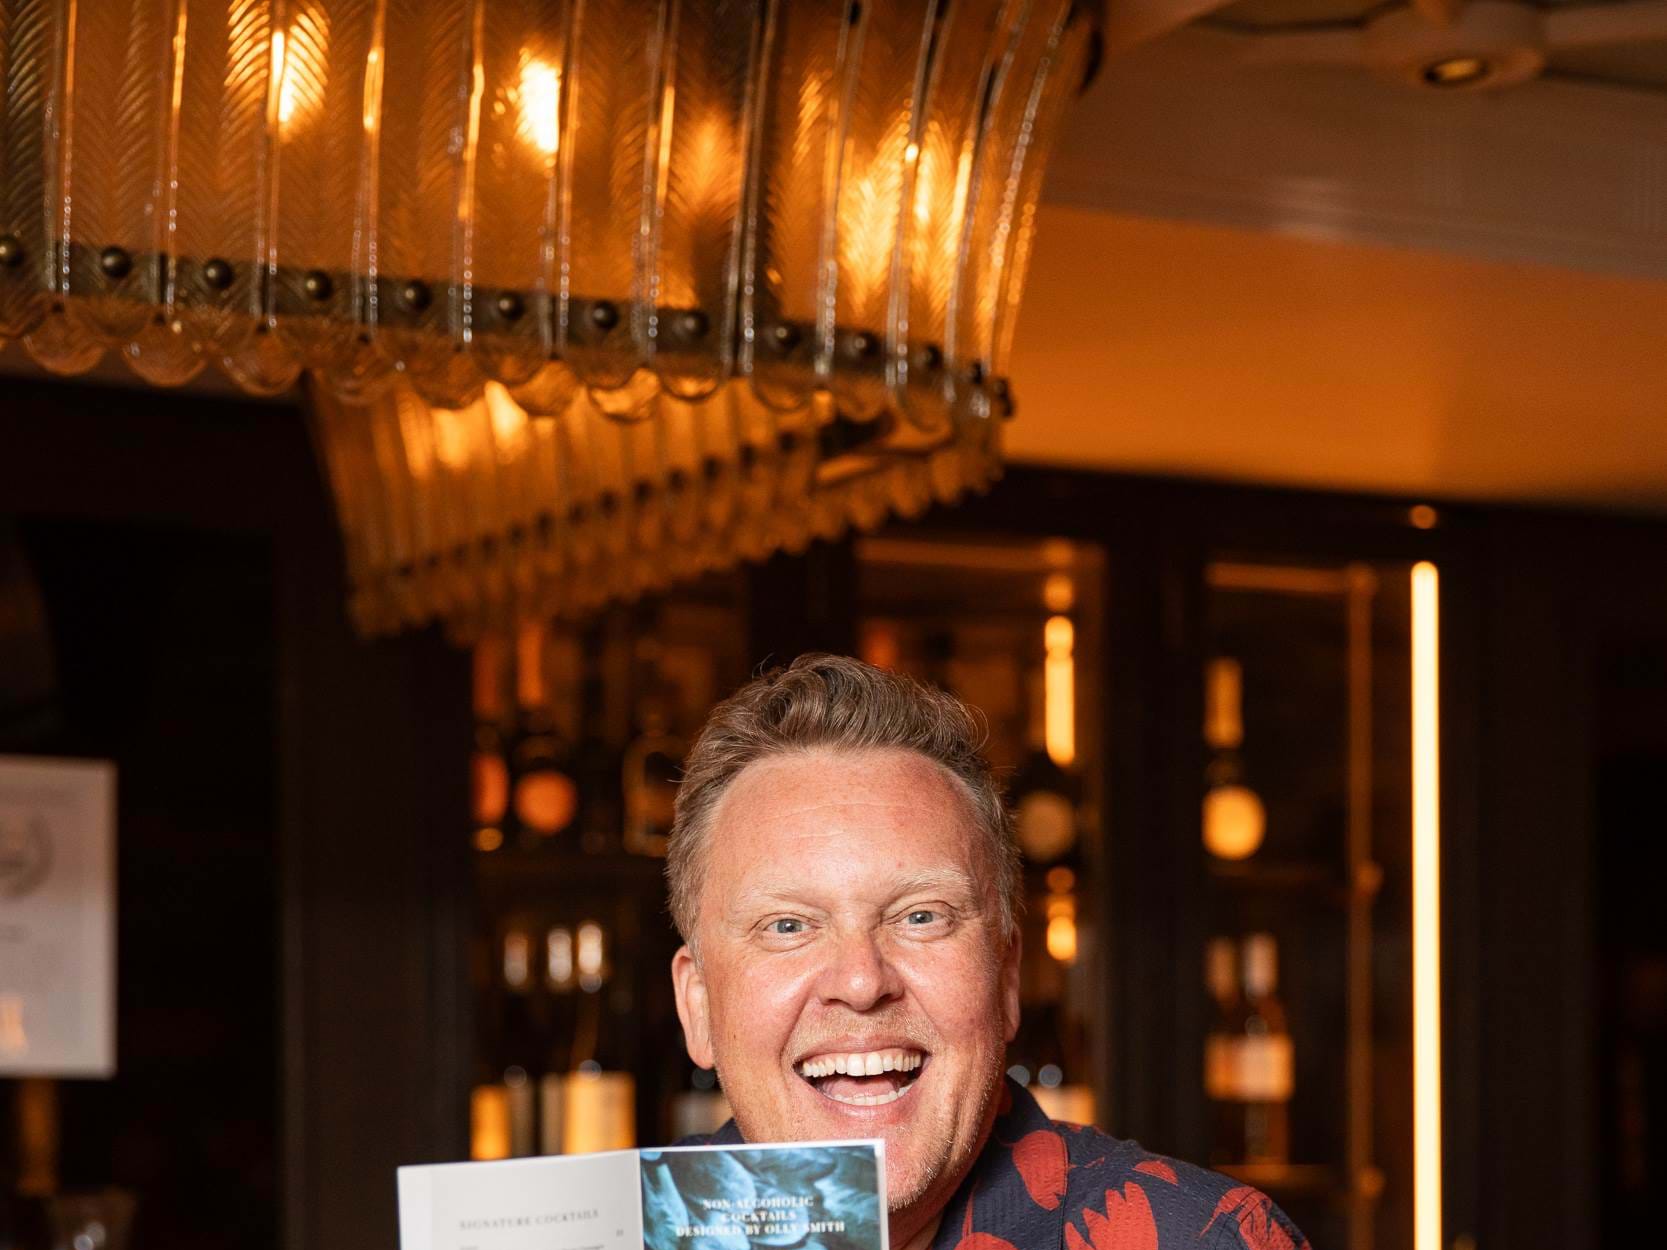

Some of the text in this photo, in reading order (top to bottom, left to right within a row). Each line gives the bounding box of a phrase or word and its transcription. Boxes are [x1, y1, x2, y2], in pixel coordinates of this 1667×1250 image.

[676, 1221, 845, 1237] DESIGNED BY OLLY SMITH
